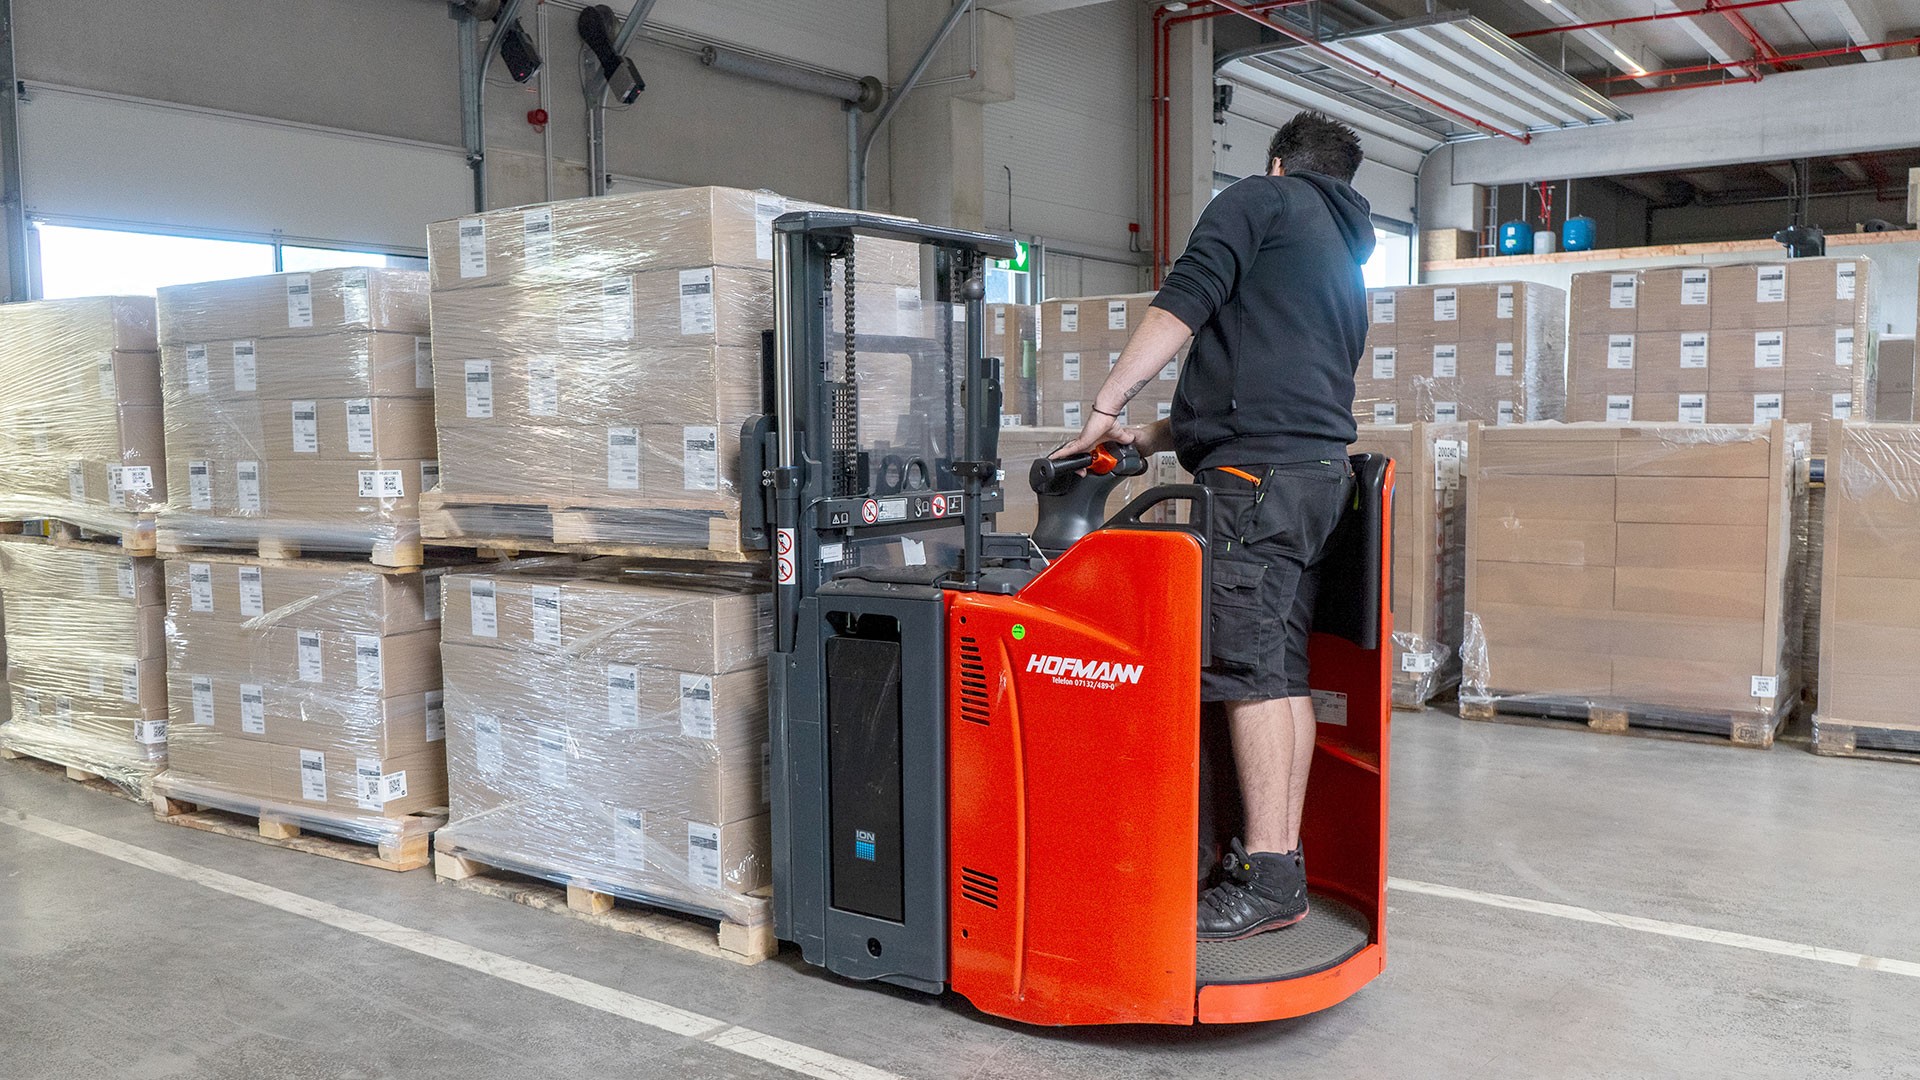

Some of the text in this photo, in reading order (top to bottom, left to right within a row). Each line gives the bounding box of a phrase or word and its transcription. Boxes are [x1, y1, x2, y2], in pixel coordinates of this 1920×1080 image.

[1026, 654, 1144, 684] HOFMANN
[1052, 676, 1115, 690] Telefon 07132/489-0
[856, 829, 875, 841] ION
